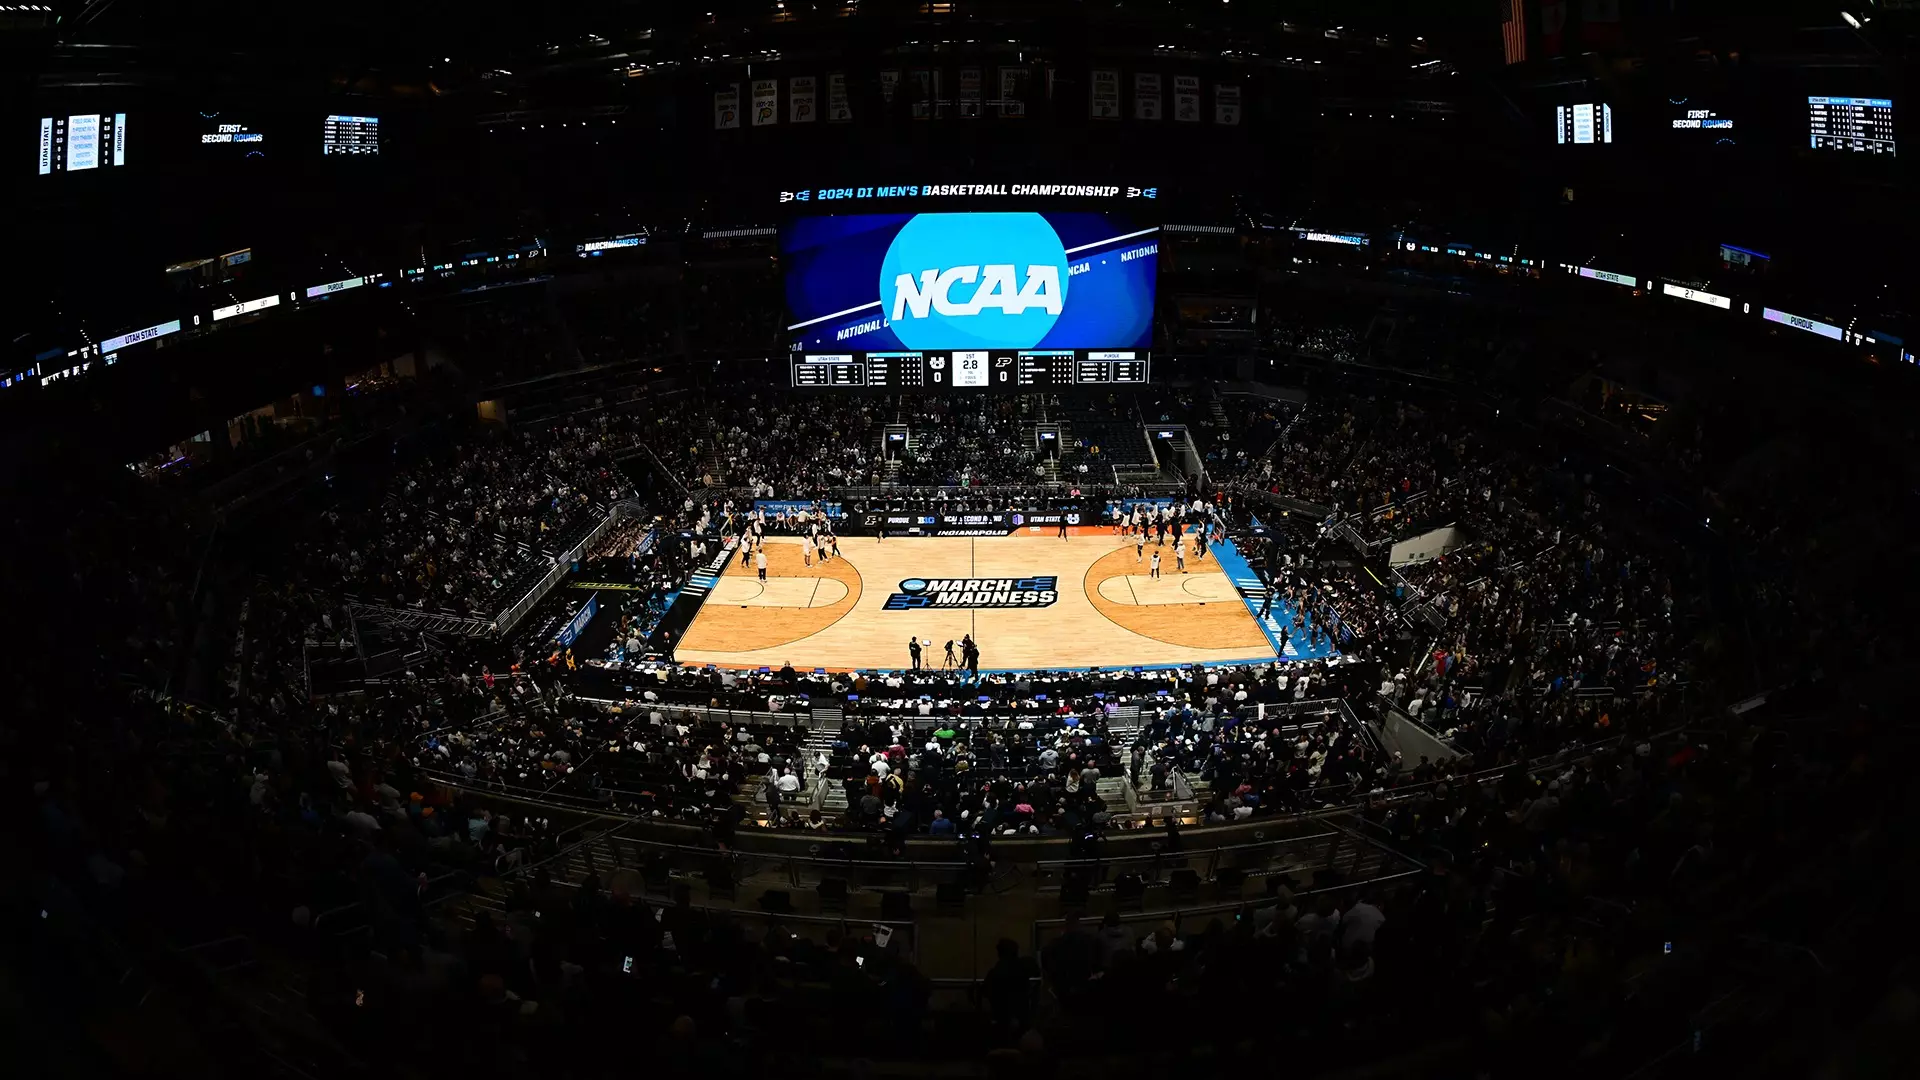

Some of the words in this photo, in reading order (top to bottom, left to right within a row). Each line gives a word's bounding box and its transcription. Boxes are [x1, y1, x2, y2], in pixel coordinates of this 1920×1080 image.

[1687, 110, 1710, 119] FIRST
[219, 124, 242, 133] FIRST
[1672, 120, 1701, 129] SECOND
[1702, 120, 1733, 128] ROUNDS
[202, 134, 232, 143] SECOND
[233, 134, 263, 142] ROUNDS
[818, 188, 853, 200] 2024
[856, 187, 874, 198] DI
[877, 185, 918, 197] MEN'S
[922, 184, 1008, 196] BASKETBALL
[1011, 184, 1119, 197] CHAMPIONSHIP
[1068, 262, 1090, 276] NCAA
[1595, 271, 1606, 279] UTAH
[1607, 273, 1619, 282] STATE
[327, 282, 344, 291] PURDUE
[892, 264, 1063, 321] NCAA
[1685, 289, 1694, 299] 2.7
[236, 303, 245, 314] 2.7
[1744, 302, 1750, 313] 0
[194, 314, 199, 325] 0
[1790, 316, 1814, 331] PURDUE
[837, 319, 881, 341] NATIONAL
[124, 332, 140, 345] UTAH
[141, 327, 158, 340] STATE
[963, 360, 978, 369] 2.8
[934, 371, 941, 382] 0
[1000, 371, 1007, 382] 0
[926, 579, 1013, 592] MARCH
[935, 590, 1055, 604] MADNESS
